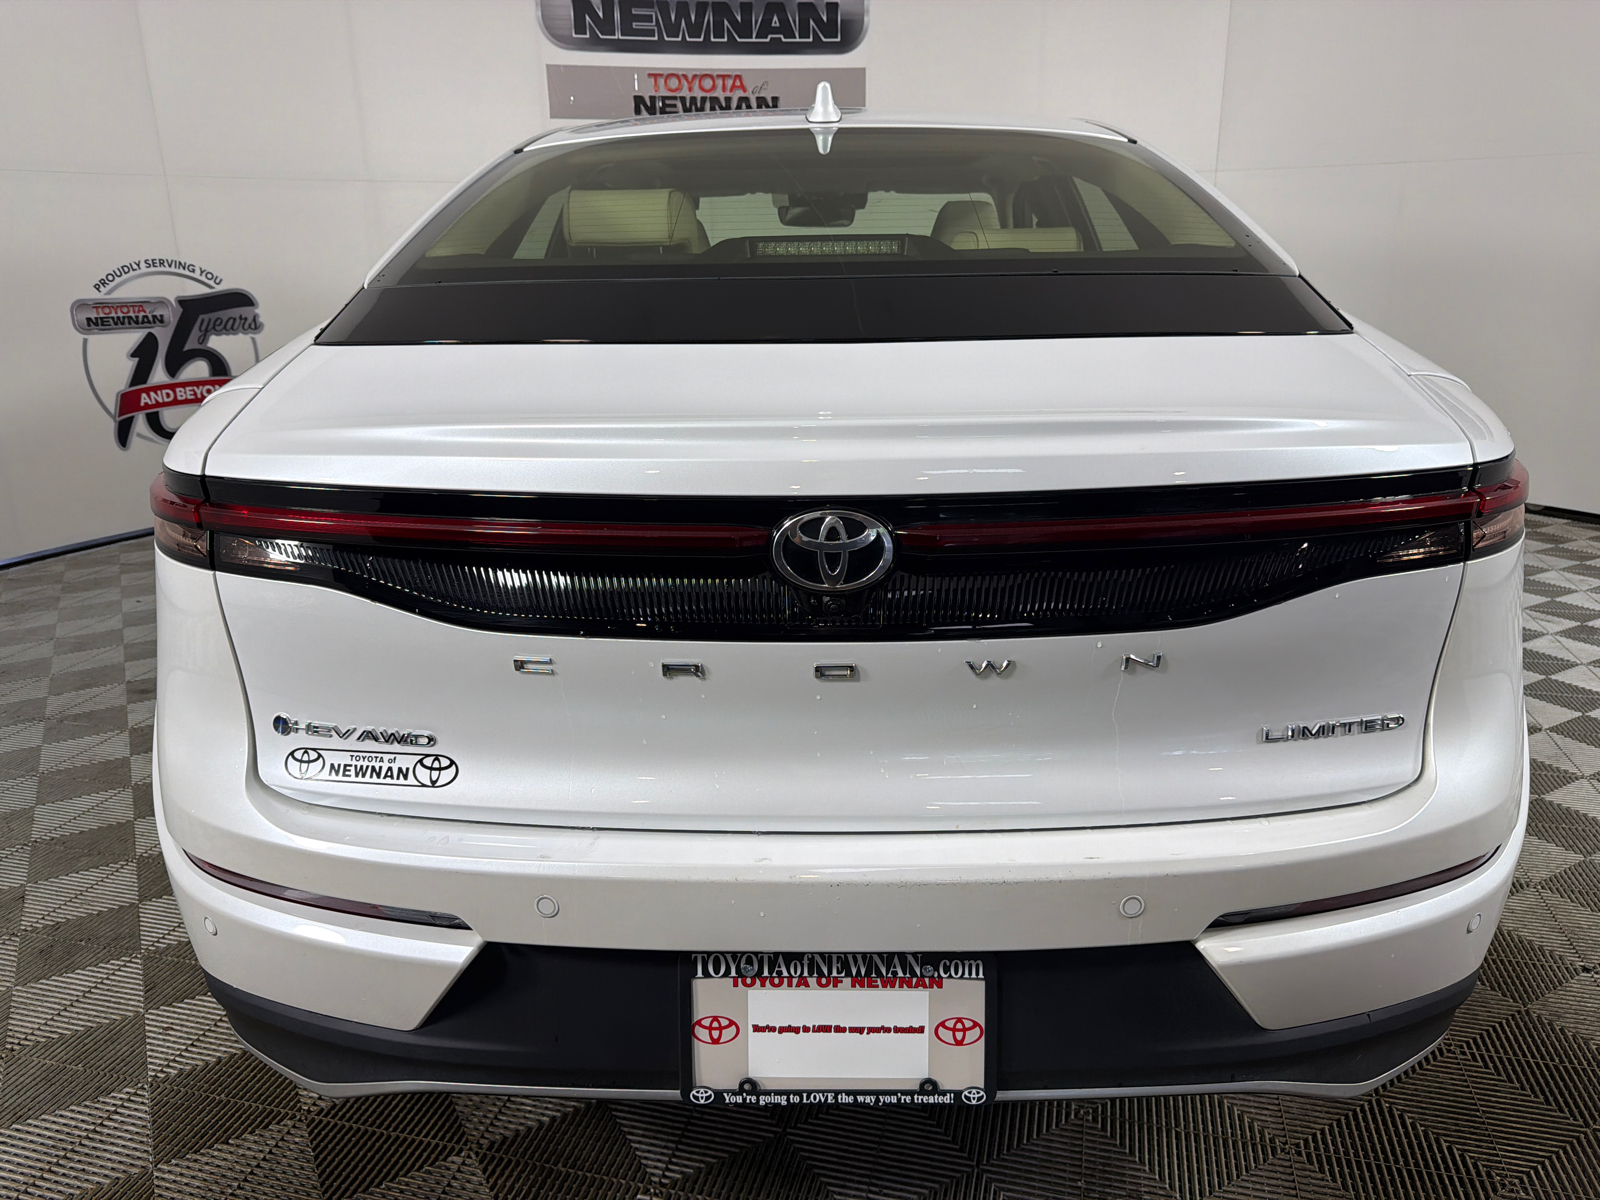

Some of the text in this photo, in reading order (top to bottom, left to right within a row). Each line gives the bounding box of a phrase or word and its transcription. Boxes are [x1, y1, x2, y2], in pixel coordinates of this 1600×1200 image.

[572, 0, 842, 42] NEWNAN
[647, 73, 769, 95] TOYOTA of
[633, 95, 780, 116] NEWNAN
[93, 258, 223, 293] PROUDLY SERVING YOU
[92, 304, 147, 316] TOYOTA
[85, 314, 165, 328] NEWNAN
[197, 313, 262, 346] years
[140, 389, 174, 407] AND
[513, 652, 1163, 679] CROWN
[356, 726, 437, 747] AWD
[1261, 713, 1405, 742] LIMITED
[349, 754, 397, 764] TOYOTA of
[328, 763, 410, 781] NEWNAN
[731, 976, 944, 990] TOYOTA OF NEWNAN
[759, 1093, 787, 1105] going
[789, 1094, 800, 1103] to
[802, 1093, 835, 1104] LOVE
[837, 1093, 854, 1104] the
[856, 1095, 876, 1105] way
[913, 1093, 955, 1104] treated!
